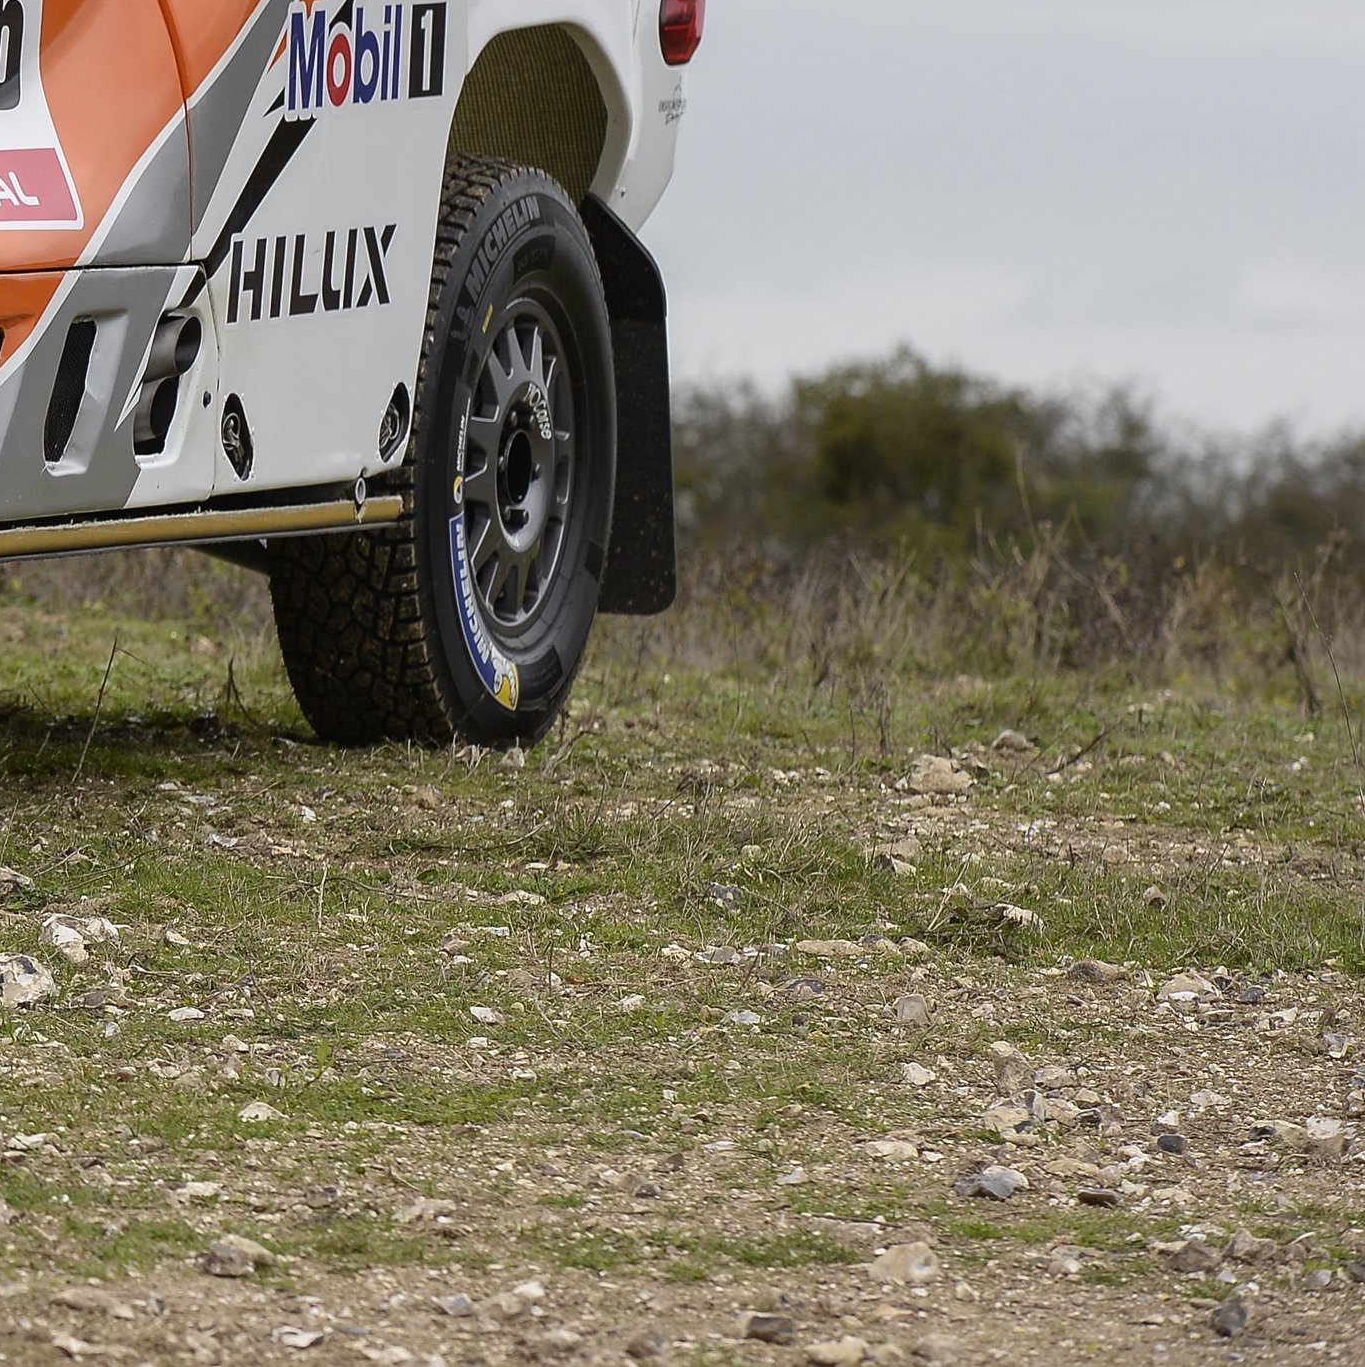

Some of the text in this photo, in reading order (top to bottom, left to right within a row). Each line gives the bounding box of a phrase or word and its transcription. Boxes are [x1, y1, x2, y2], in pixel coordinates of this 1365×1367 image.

[288, 4, 402, 110] Mobil
[226, 224, 397, 324] HILUX
[465, 195, 540, 304] MICHELIN
[455, 523, 491, 664] MICHELIN
